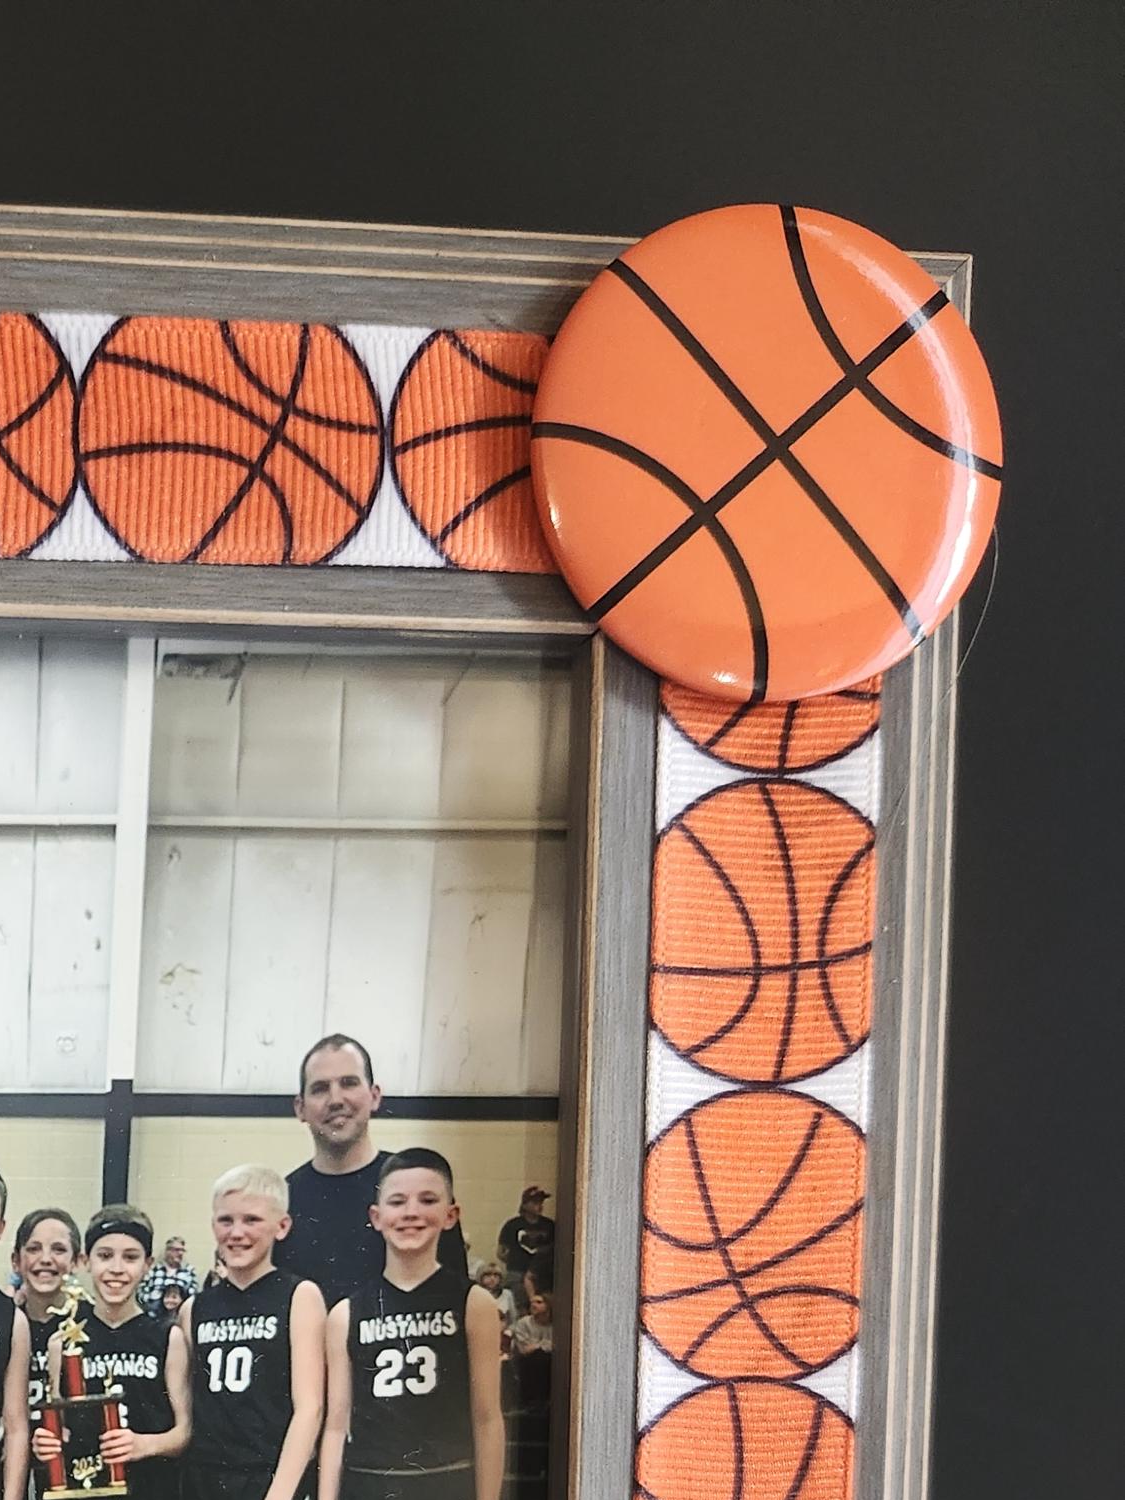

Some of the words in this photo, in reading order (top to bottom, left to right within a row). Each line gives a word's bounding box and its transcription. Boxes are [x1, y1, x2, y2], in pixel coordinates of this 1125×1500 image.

[197, 1315, 277, 1344] MUSTANGS
[359, 1310, 457, 1344] MUSTANGS
[207, 1346, 253, 1392] 10
[373, 1345, 437, 1397] 23
